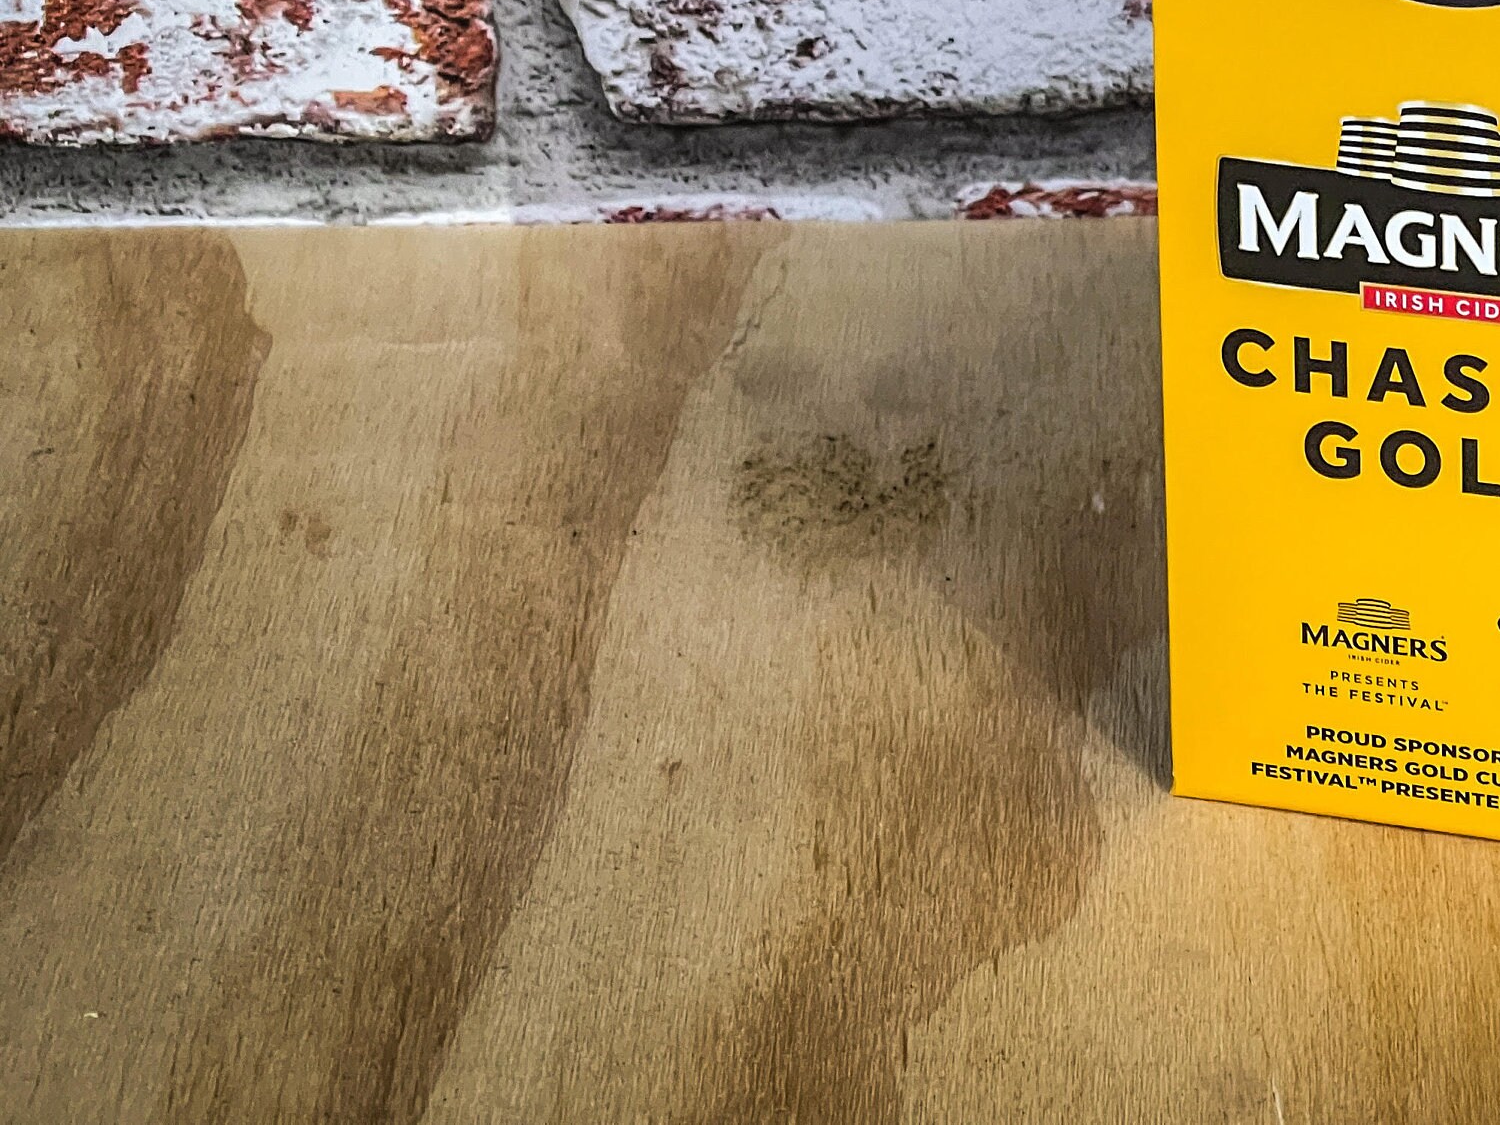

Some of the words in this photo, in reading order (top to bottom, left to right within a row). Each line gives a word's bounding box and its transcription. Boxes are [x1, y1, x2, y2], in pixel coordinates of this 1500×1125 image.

[1374, 290, 1445, 314] IRISH
[1301, 622, 1448, 662] MAGNERS
[1302, 682, 1338, 697] THE
[1330, 670, 1419, 691] PRESENTS
[1306, 725, 1387, 748] PROUD
[1286, 745, 1398, 773] MAGNERS
[1404, 762, 1469, 782] GOLD
